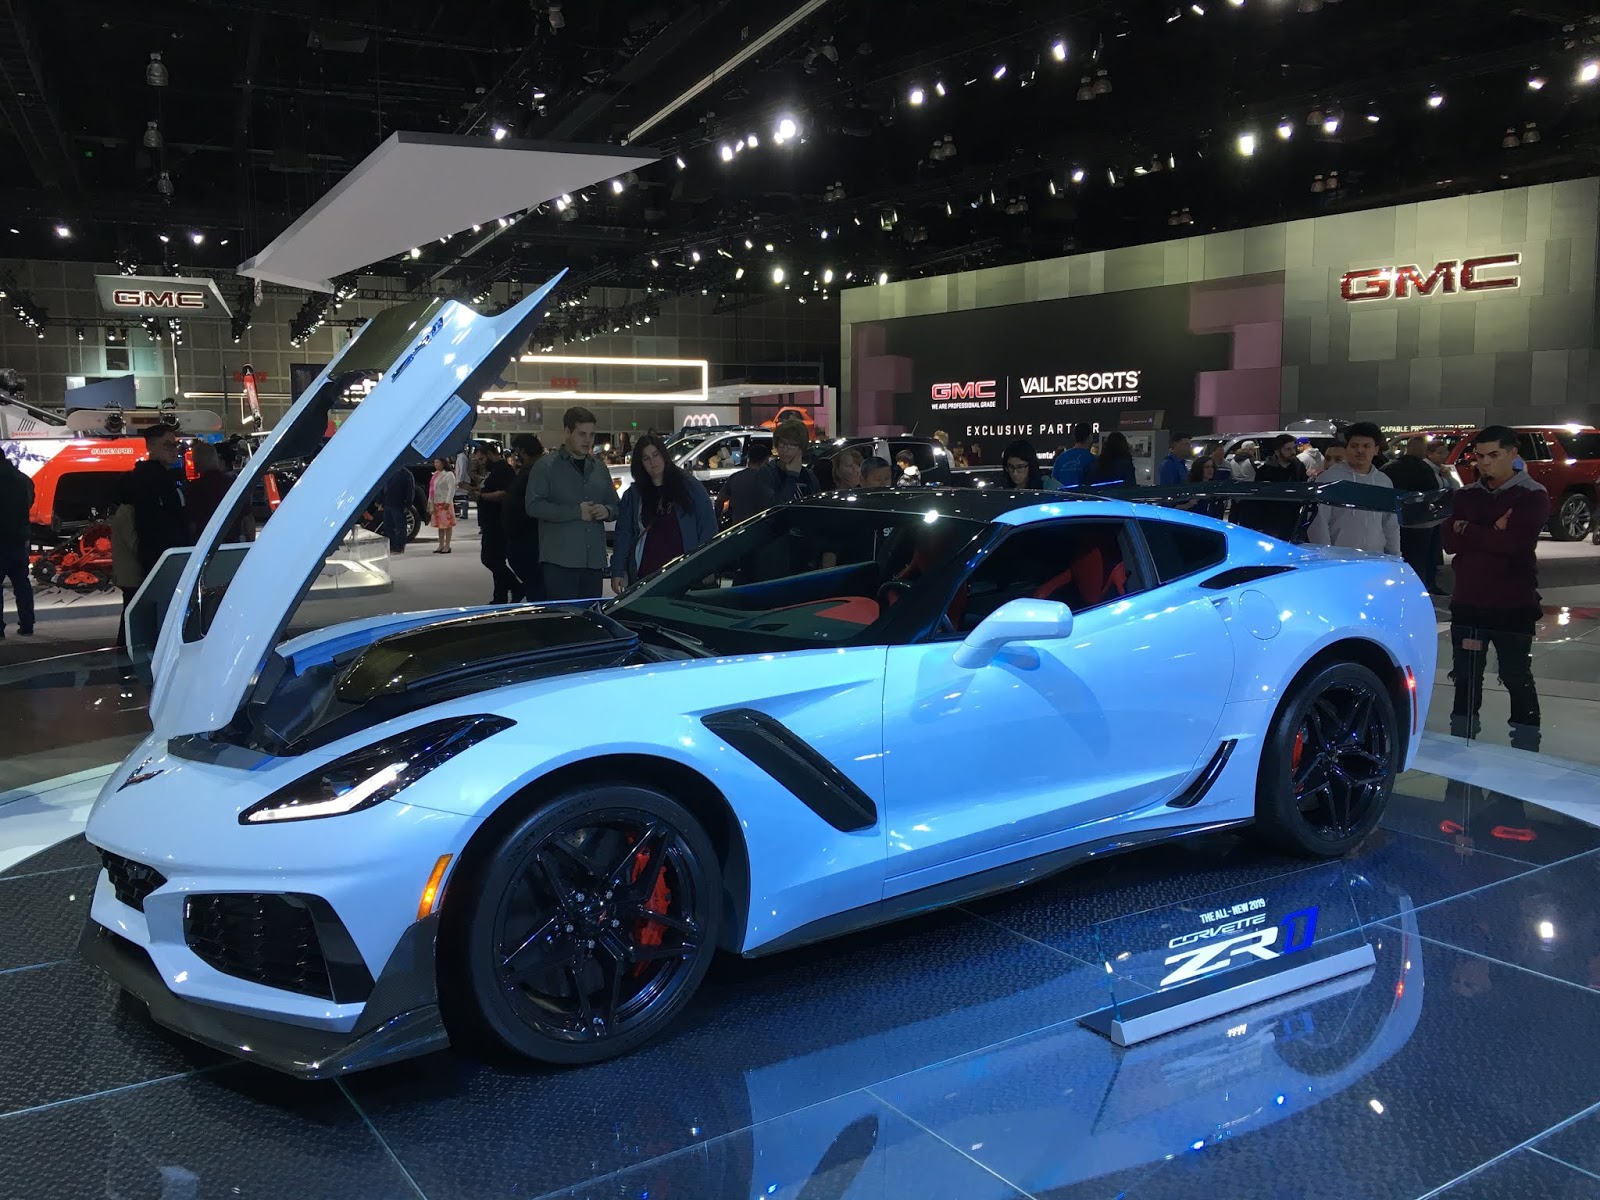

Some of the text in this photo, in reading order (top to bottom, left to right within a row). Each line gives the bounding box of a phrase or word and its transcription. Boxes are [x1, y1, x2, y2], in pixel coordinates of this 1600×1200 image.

[1340, 252, 1522, 303] GMC
[113, 289, 204, 308] GMC
[931, 380, 996, 400] GMC
[966, 422, 1100, 436] EXCLUSIVE PARTR
[1200, 911, 1216, 924] THE
[1249, 898, 1266, 913] 2019
[1168, 913, 1267, 949] CORVETTE
[1160, 905, 1320, 987] ZR1
